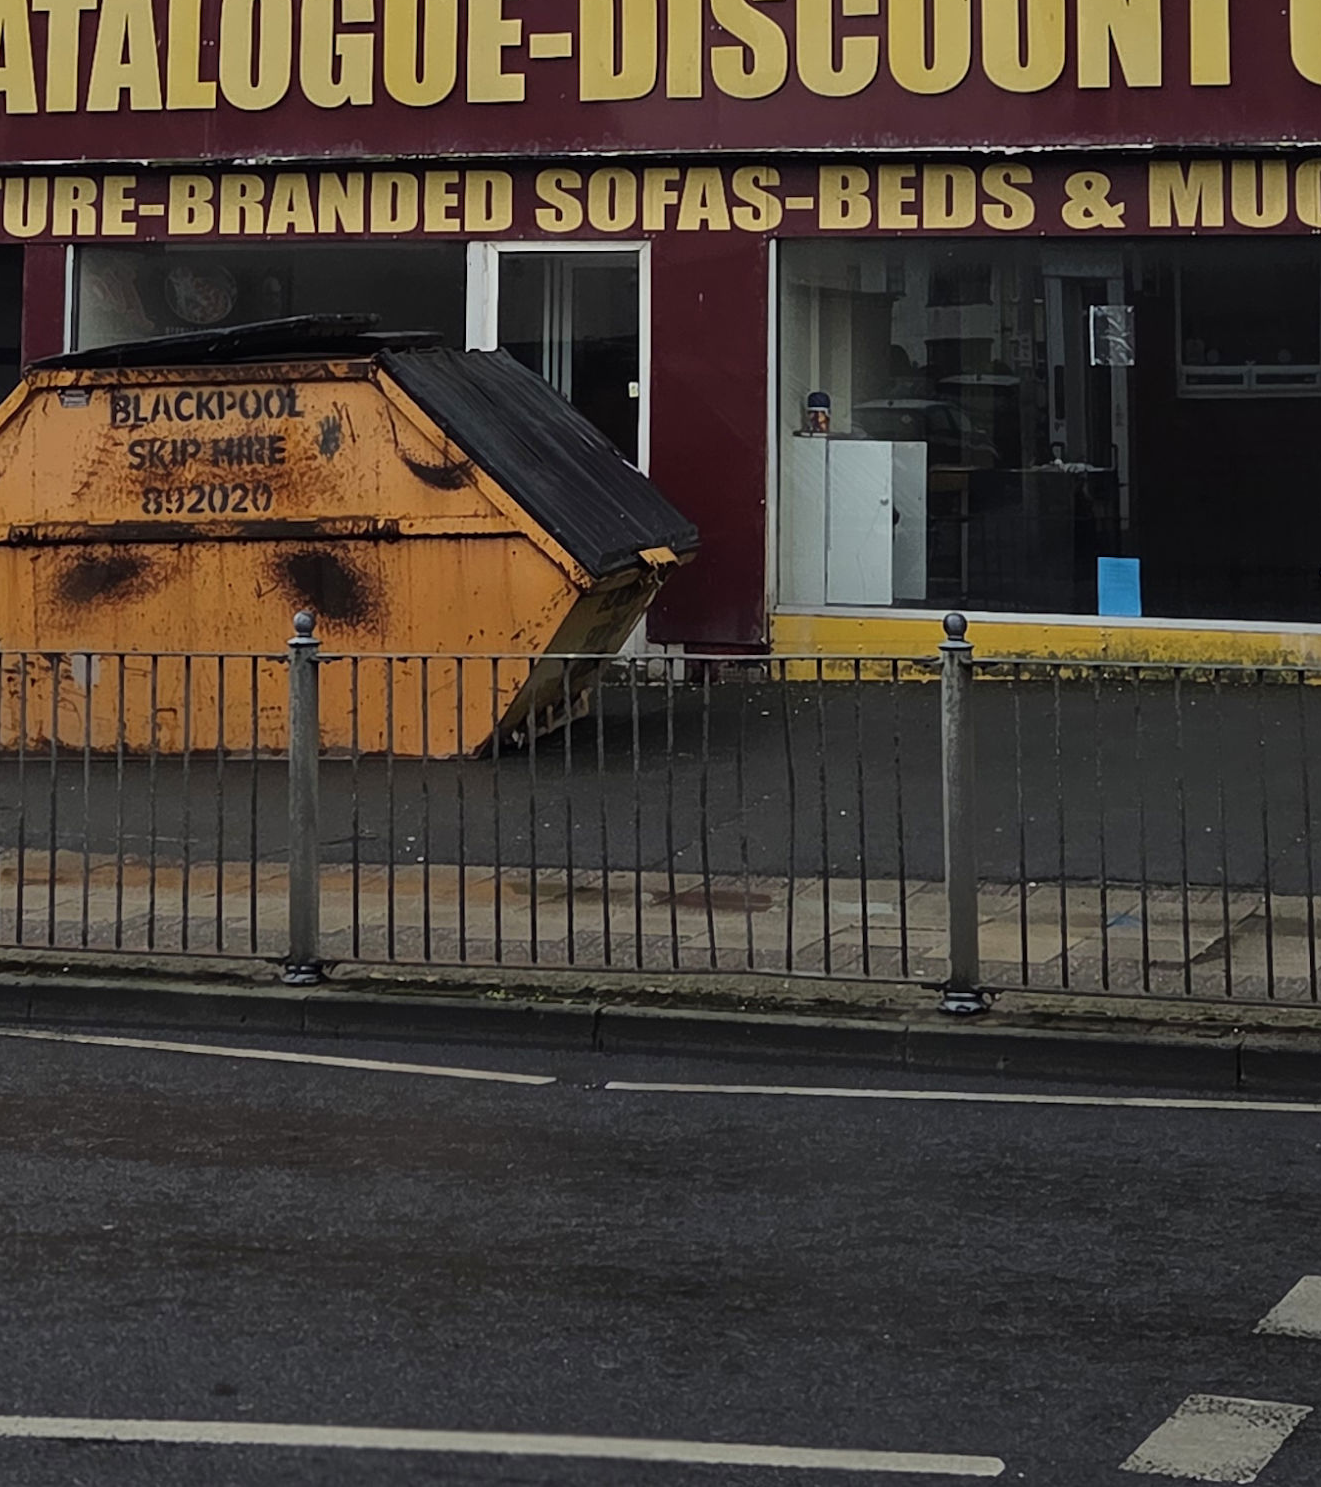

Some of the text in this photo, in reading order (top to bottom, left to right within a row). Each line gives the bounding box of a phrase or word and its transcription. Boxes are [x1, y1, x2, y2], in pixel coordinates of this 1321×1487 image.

[1061, 169, 1126, 229] &
[111, 387, 305, 425] BLACKPOOL
[128, 435, 287, 470] SKIP HIRE
[141, 483, 273, 515] 892020
